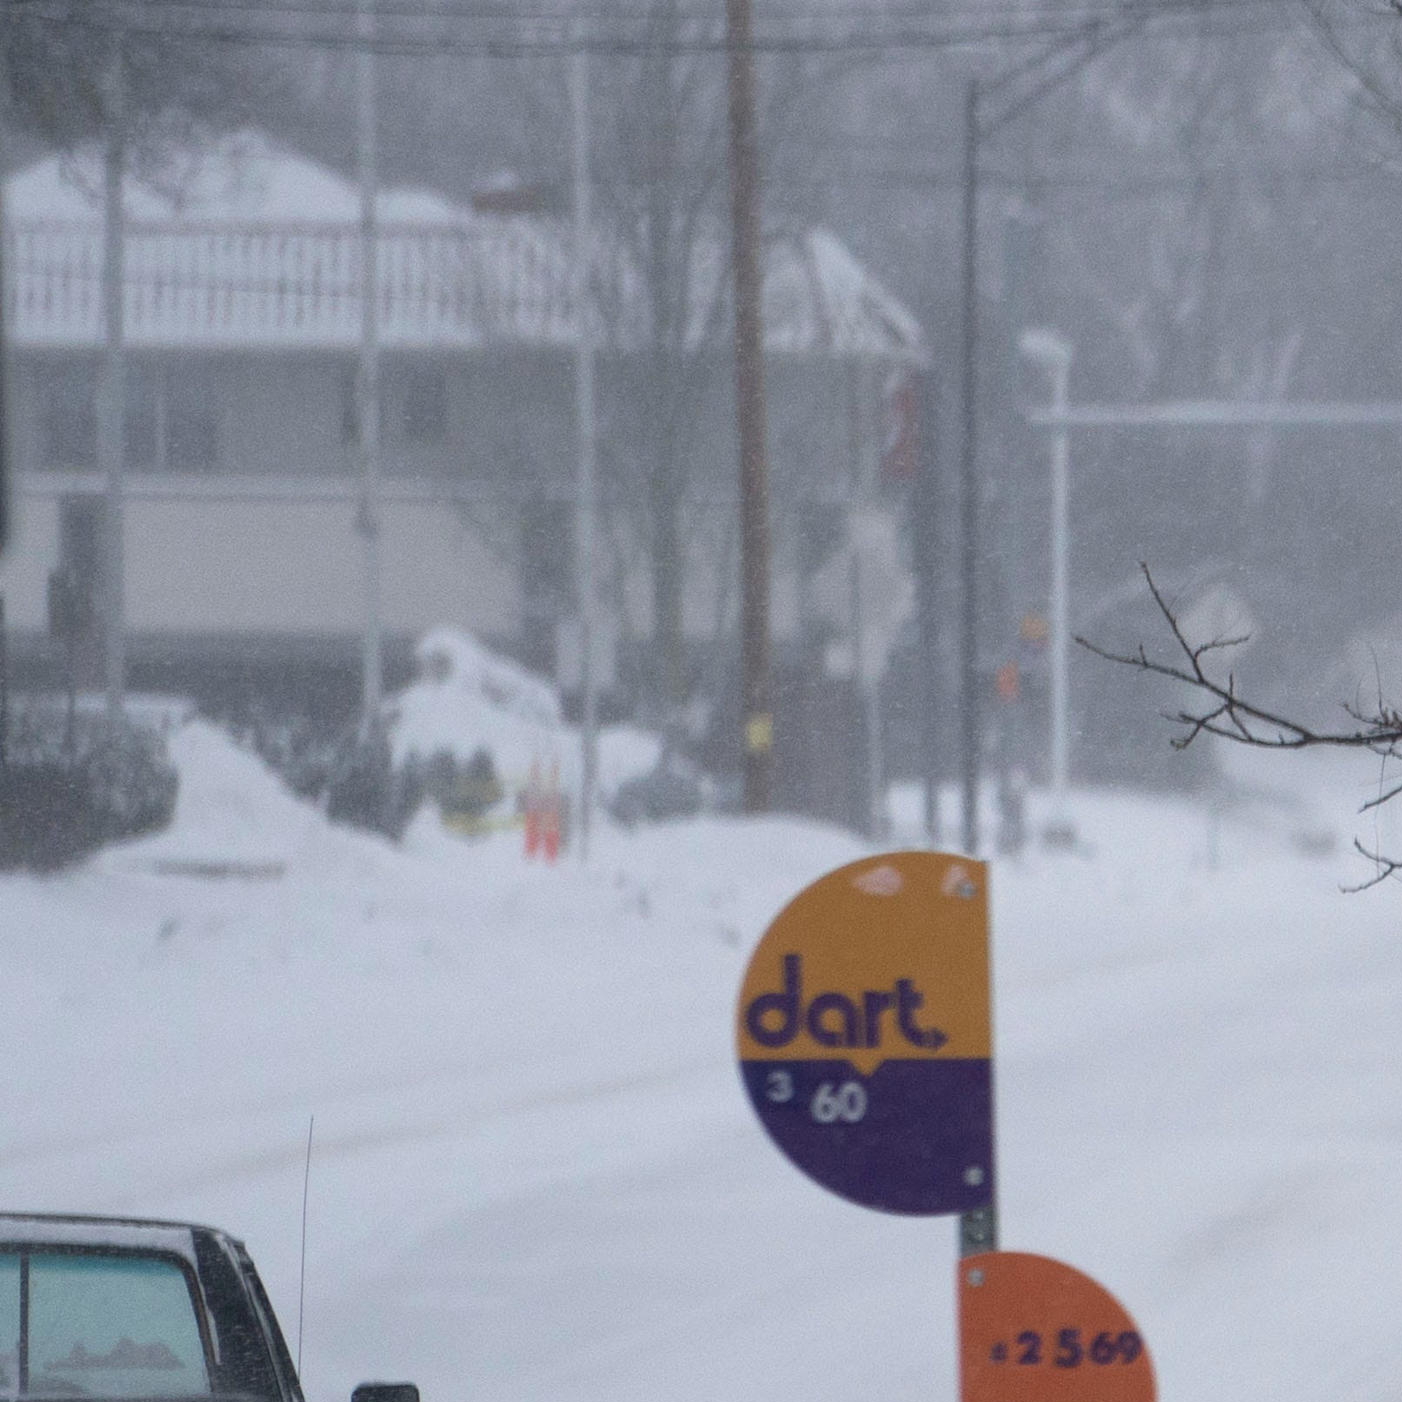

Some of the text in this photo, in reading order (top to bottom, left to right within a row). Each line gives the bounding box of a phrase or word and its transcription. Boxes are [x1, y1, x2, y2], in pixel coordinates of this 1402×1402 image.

[745, 954, 948, 1049] dart
[767, 1071, 868, 1123] 3 60
